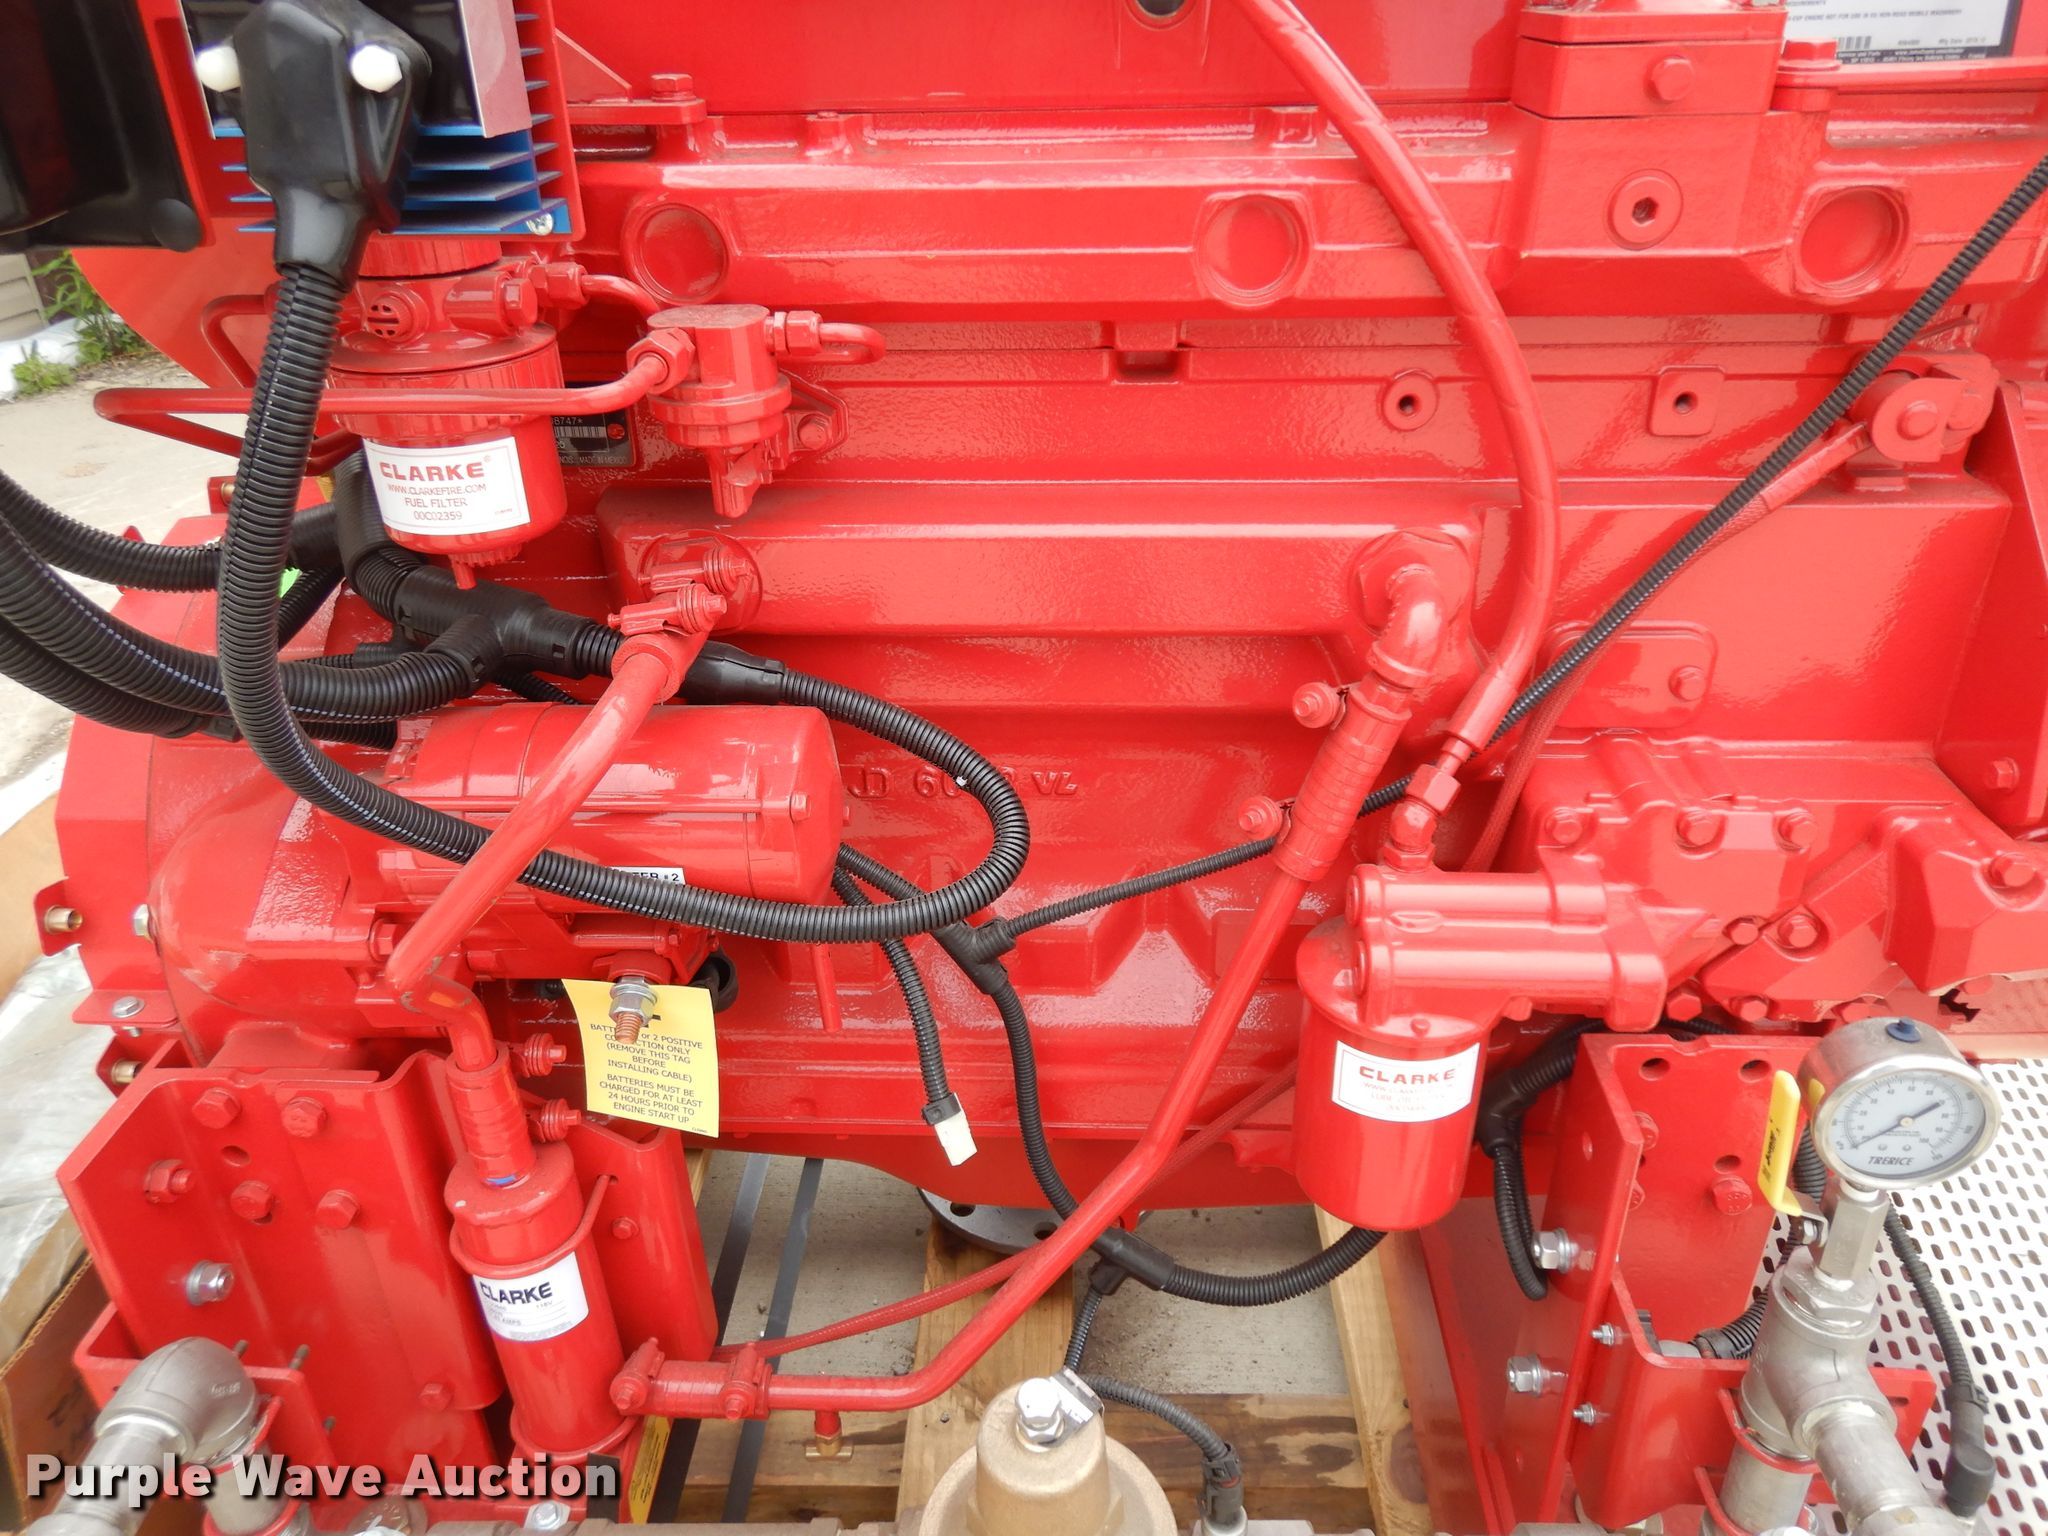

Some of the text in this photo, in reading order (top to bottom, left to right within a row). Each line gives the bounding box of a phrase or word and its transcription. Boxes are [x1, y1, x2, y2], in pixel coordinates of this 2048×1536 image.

[379, 461, 485, 482] CLARKE
[388, 483, 487, 496] WWW.CLARKEFIRE.COM
[404, 497, 468, 509] FUEL FILTER
[653, 1033, 659, 1041] 2
[661, 1035, 703, 1050] POSITIVE
[666, 1045, 691, 1056] ONLY
[606, 1042, 691, 1065] (REMOVE THIS TAG
[632, 1055, 667, 1069] BEFORE
[607, 1059, 692, 1084] INSTALLING CABLE)
[1359, 1065, 1456, 1085] CLARKE
[599, 1081, 703, 1109] CHARGED FOR AT LEAST
[607, 1073, 695, 1098] BATTERIES MUST BE
[608, 1091, 695, 1116] 24 HOURS PRIOR TO
[613, 1101, 690, 1124] ENGINE START UP
[1867, 1156, 1915, 1166] TRERICE
[480, 1281, 553, 1305] CLARKE
